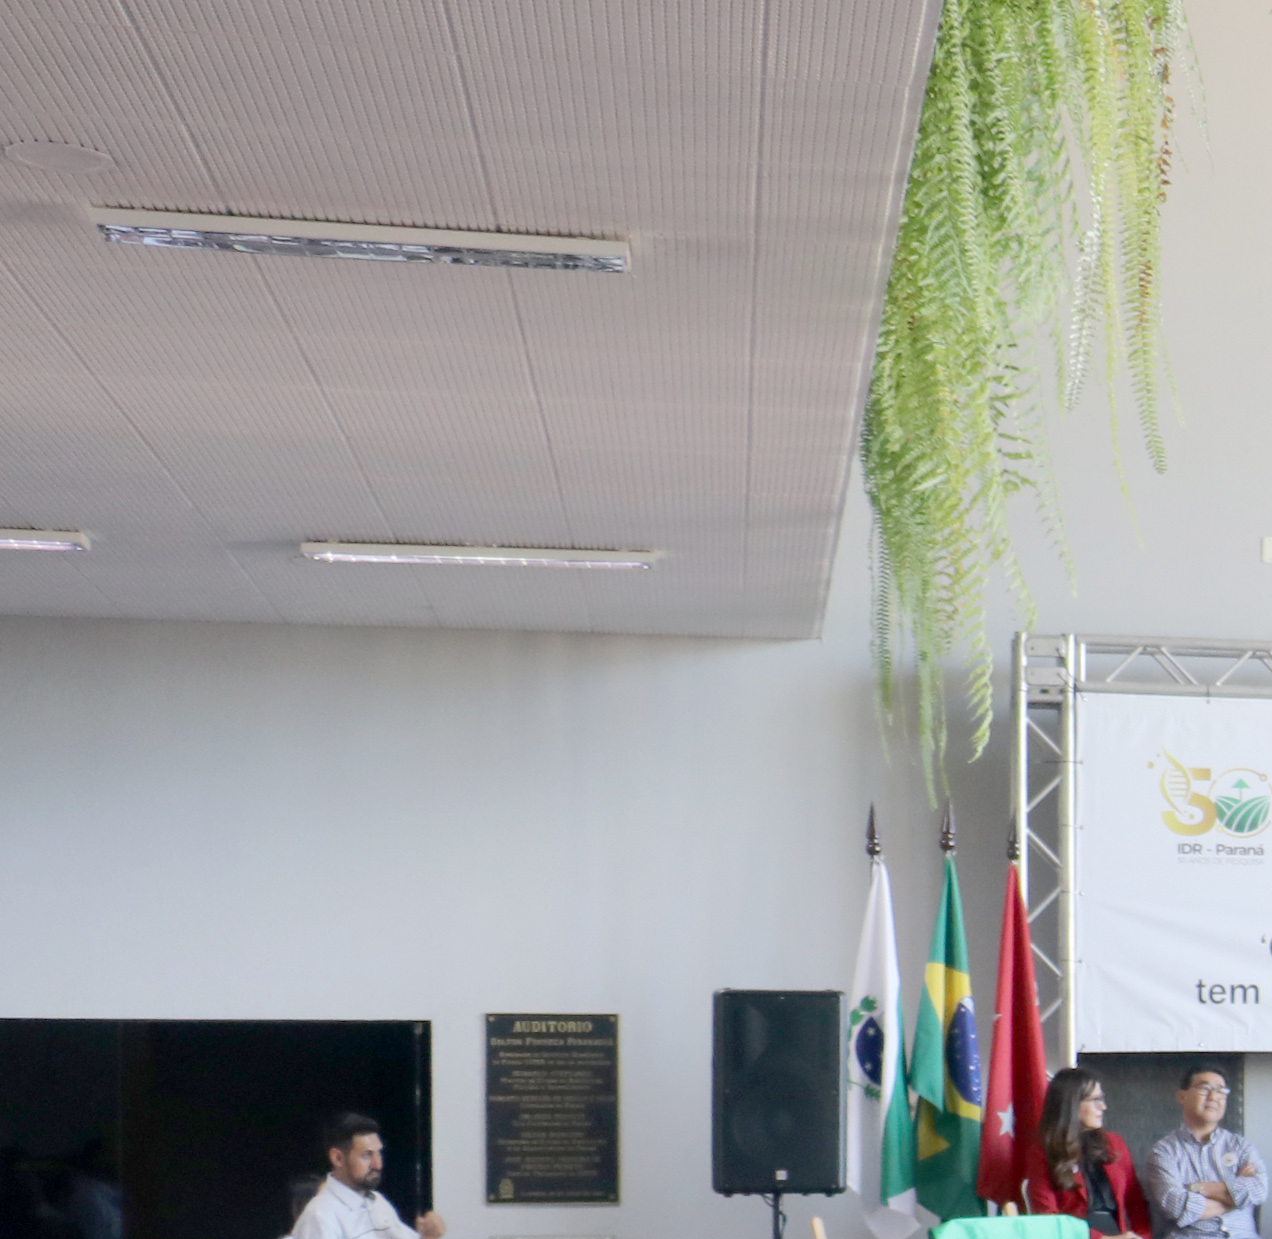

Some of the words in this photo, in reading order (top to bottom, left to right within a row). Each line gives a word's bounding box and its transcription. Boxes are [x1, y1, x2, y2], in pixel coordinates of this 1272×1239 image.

[1177, 843, 1203, 855] IDR
[1215, 843, 1265, 856] Paraná
[1196, 978, 1260, 1005] tem
